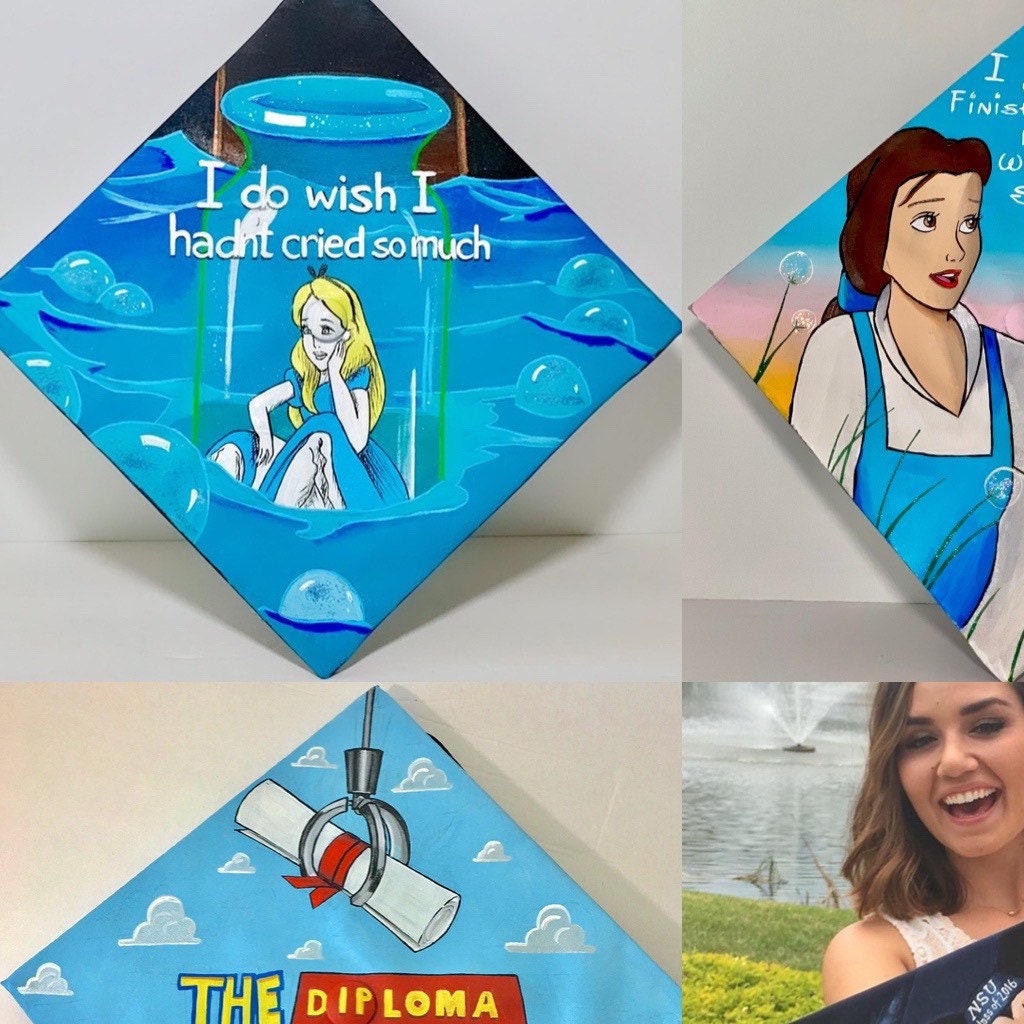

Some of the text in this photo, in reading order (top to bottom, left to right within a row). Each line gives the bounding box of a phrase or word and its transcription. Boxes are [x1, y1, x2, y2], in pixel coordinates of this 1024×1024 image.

[984, 52, 1008, 82] I
[196, 160, 437, 214] I do wish I
[281, 225, 365, 260] cried
[371, 238, 406, 260] so
[411, 224, 491, 261] much
[307, 986, 499, 1018] DIPLOMA
[967, 979, 997, 1021] NSU
[991, 997, 1002, 1011] of
[997, 979, 1018, 1001] 2016
